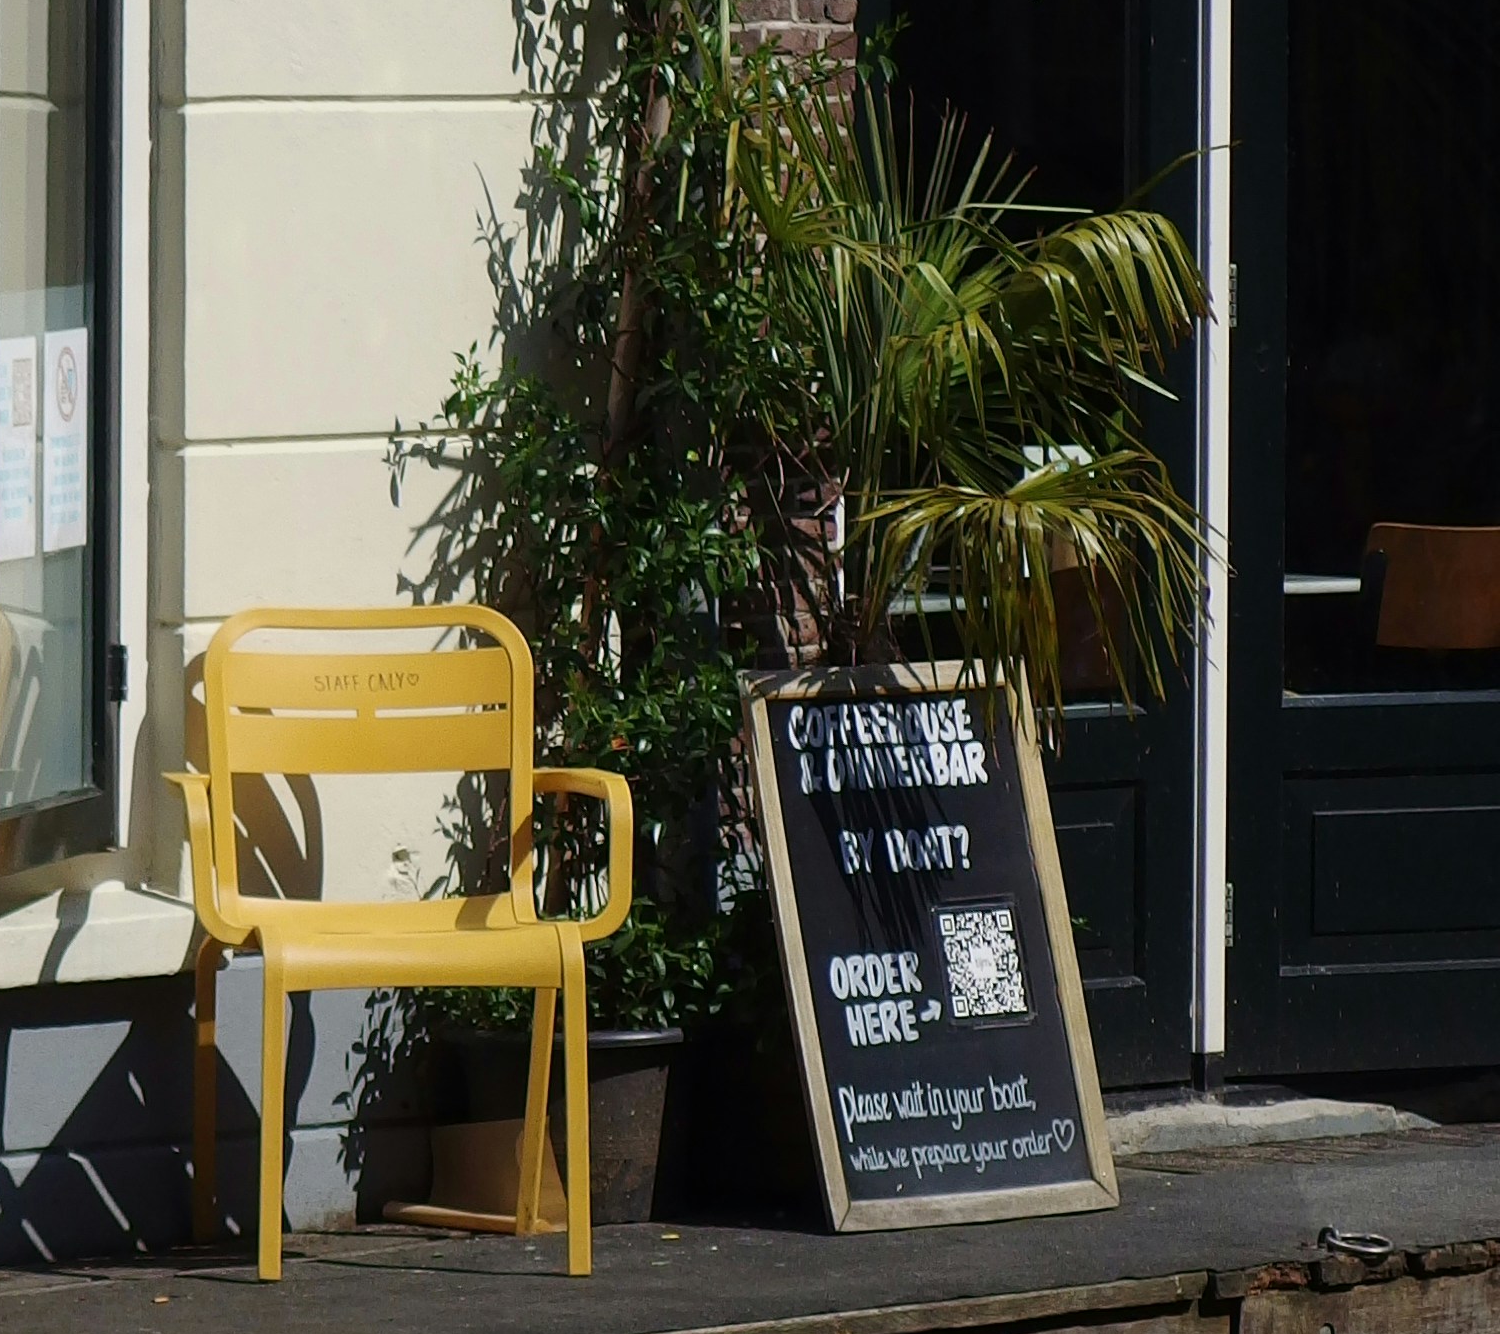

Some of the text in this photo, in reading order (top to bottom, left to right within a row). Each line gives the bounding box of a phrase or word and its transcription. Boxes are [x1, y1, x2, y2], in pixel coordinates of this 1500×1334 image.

[314, 675, 359, 692] STAFF
[788, 698, 973, 750] COFFEEHOUSE
[800, 751, 822, 795] &
[839, 825, 971, 874] BY BOAT?
[830, 951, 922, 1000] ORDER
[845, 999, 919, 1047] HERE
[838, 1074, 1036, 1143] Please wait in your boat,
[850, 1129, 1053, 1179] while we prepare your order
